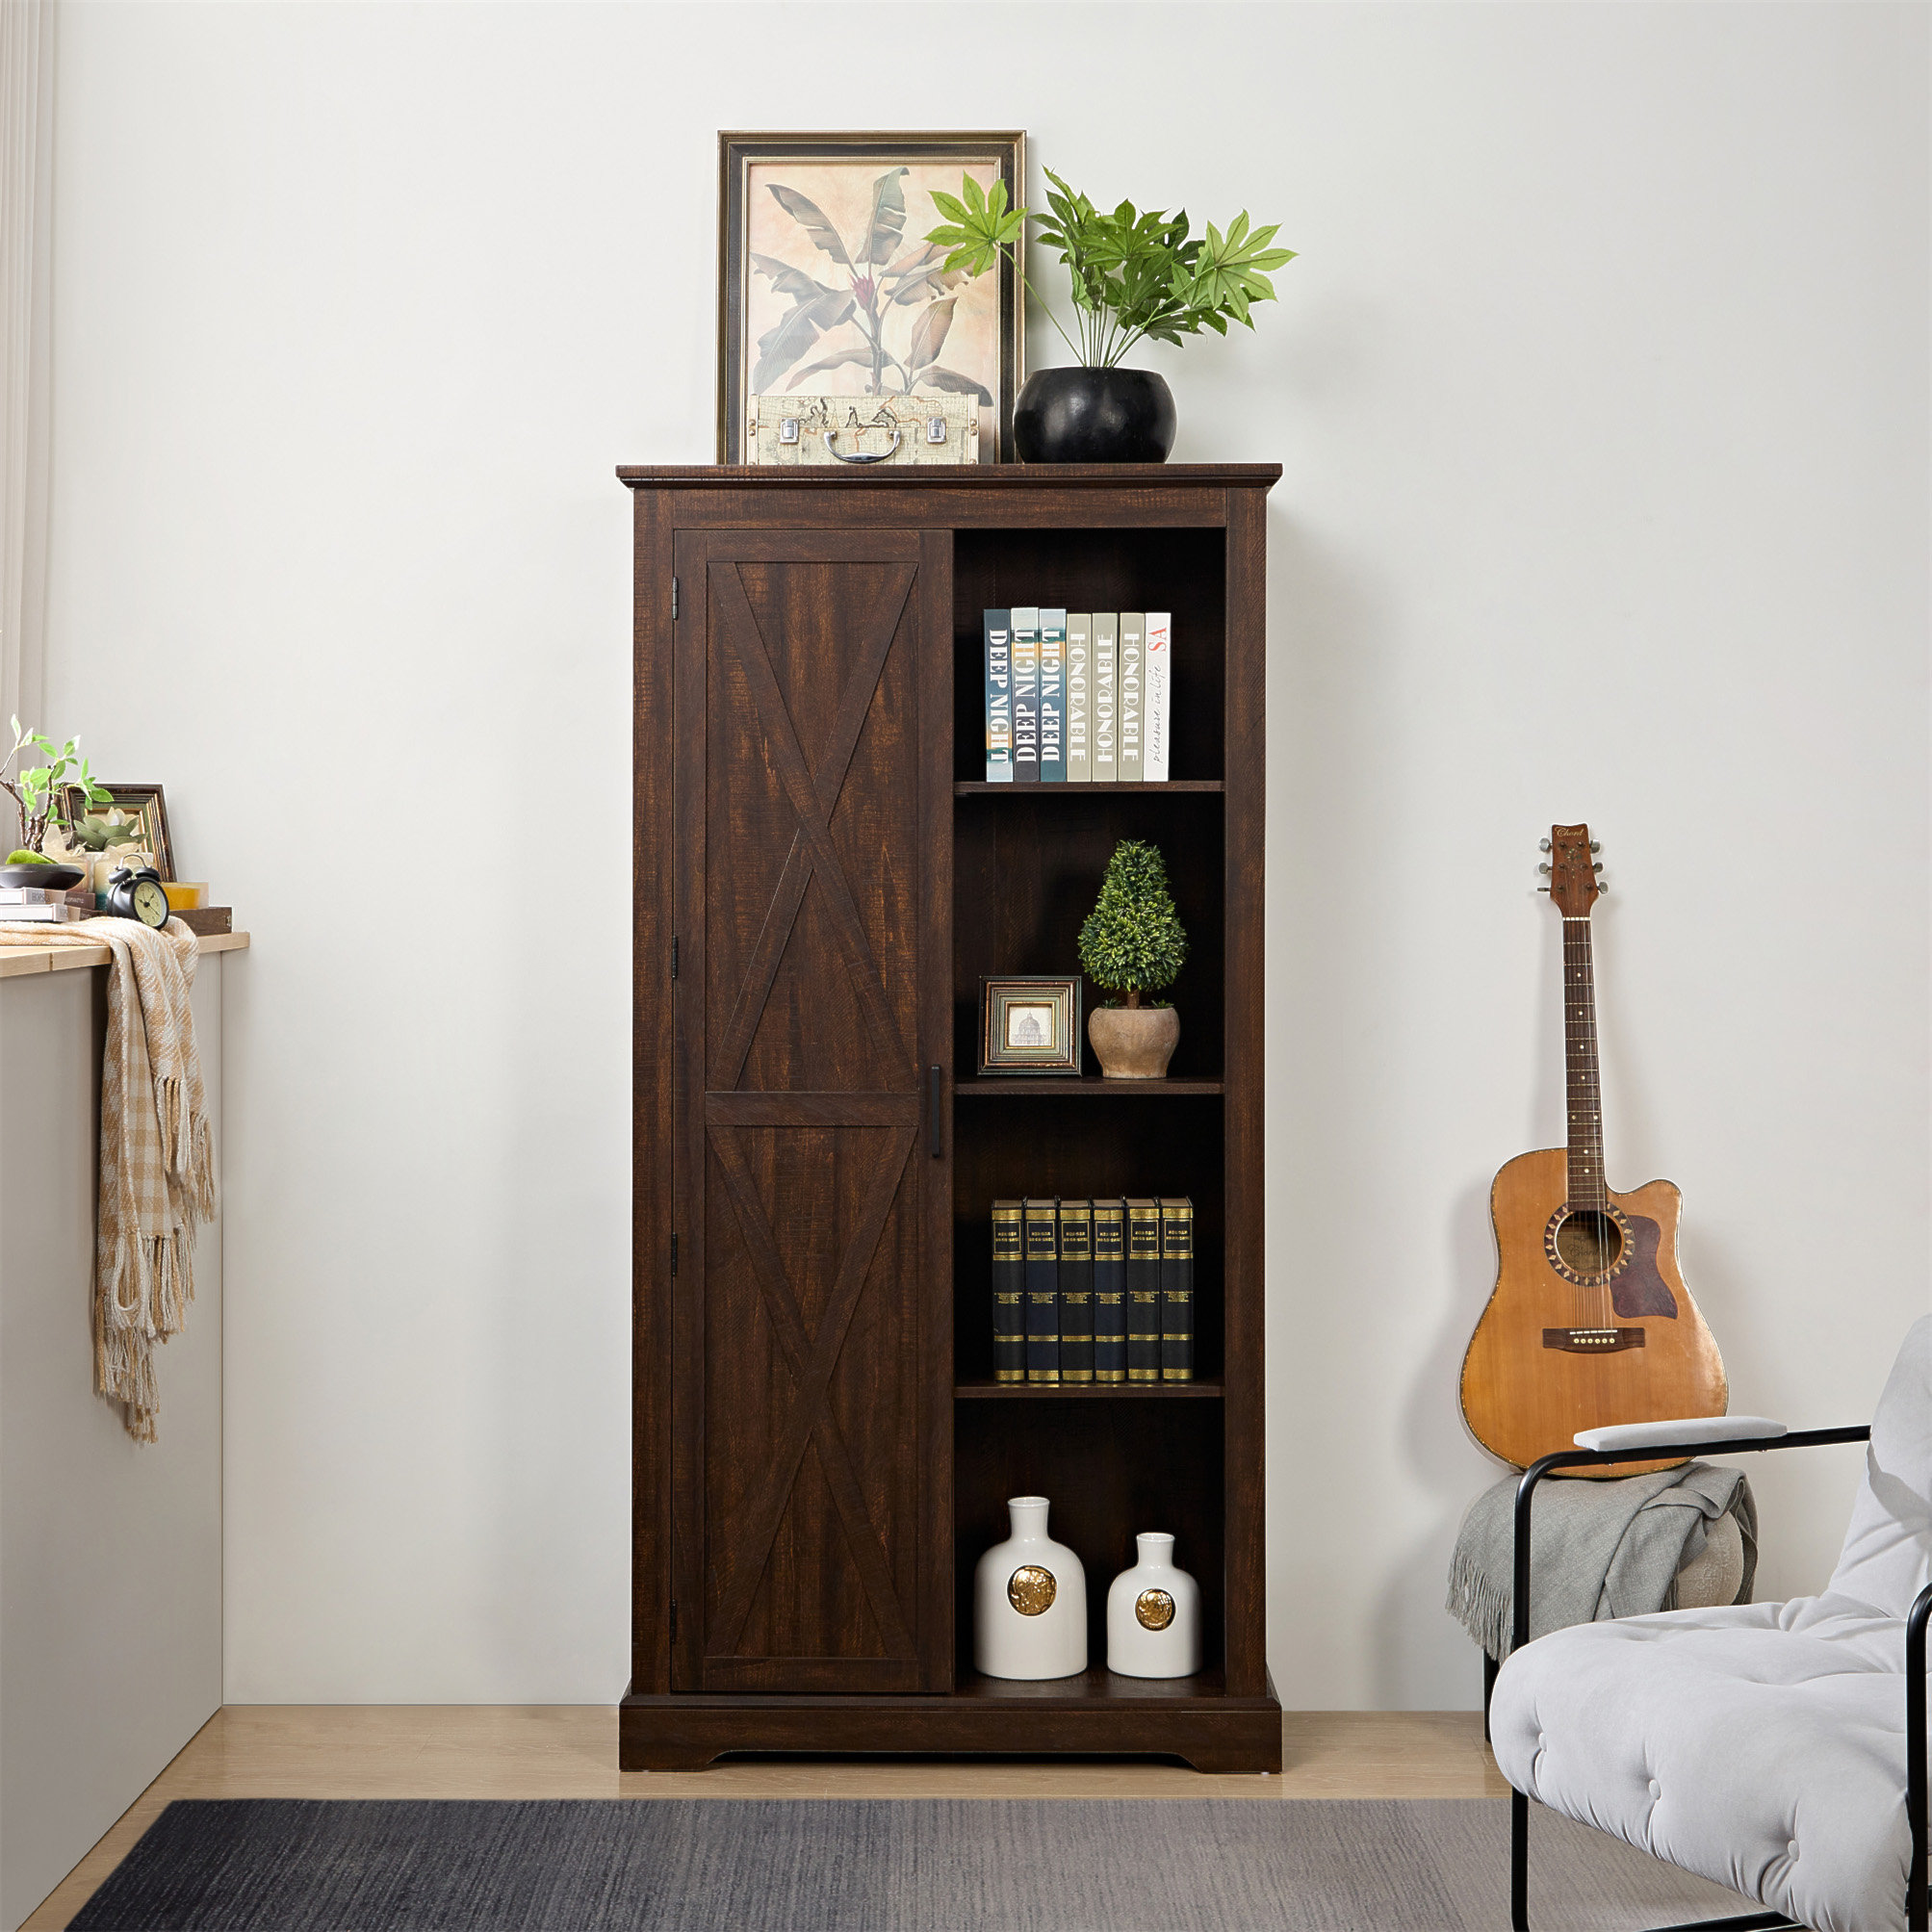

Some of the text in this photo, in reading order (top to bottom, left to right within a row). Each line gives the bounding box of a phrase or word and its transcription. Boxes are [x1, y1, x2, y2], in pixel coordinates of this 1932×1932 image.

[989, 629, 1009, 763] DEEP NIGHT
[1015, 629, 1037, 762] DEEP NIGHT
[1042, 627, 1061, 761] DEEP NIGHT
[1069, 632, 1086, 761] HONORABLE
[1097, 633, 1114, 762] HONORABLE
[1122, 632, 1140, 761] HONORABLE
[1147, 627, 1167, 652] SA
[1147, 664, 1166, 764] pleasure in life
